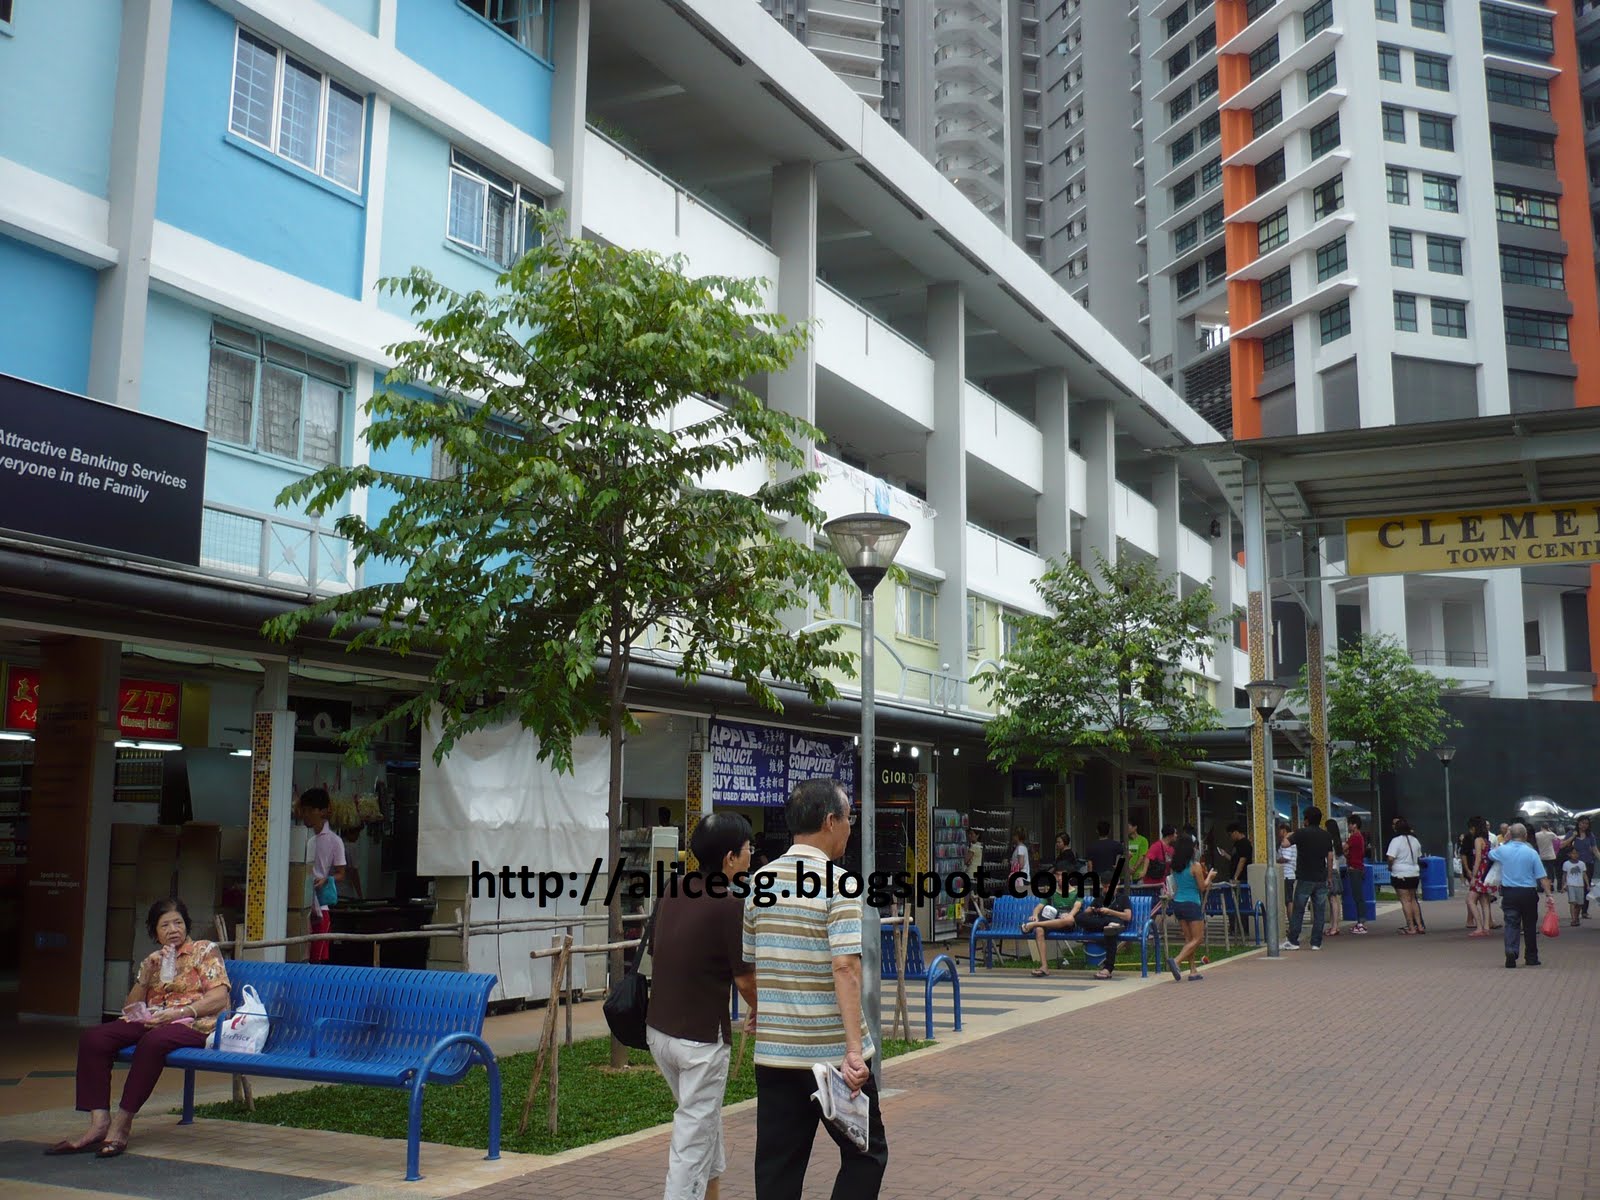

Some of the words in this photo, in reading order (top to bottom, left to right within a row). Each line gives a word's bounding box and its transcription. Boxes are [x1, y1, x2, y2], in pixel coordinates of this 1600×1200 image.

[0, 428, 67, 460] Attractive
[70, 447, 129, 477] Banking
[131, 462, 188, 490] Services
[59, 467, 74, 483] in
[77, 473, 100, 489] the
[103, 476, 150, 503] Family
[1377, 506, 1600, 549] CLEME
[1446, 545, 1517, 564] TOWN
[121, 689, 176, 715] ZTP
[788, 754, 836, 773] COMPUTER
